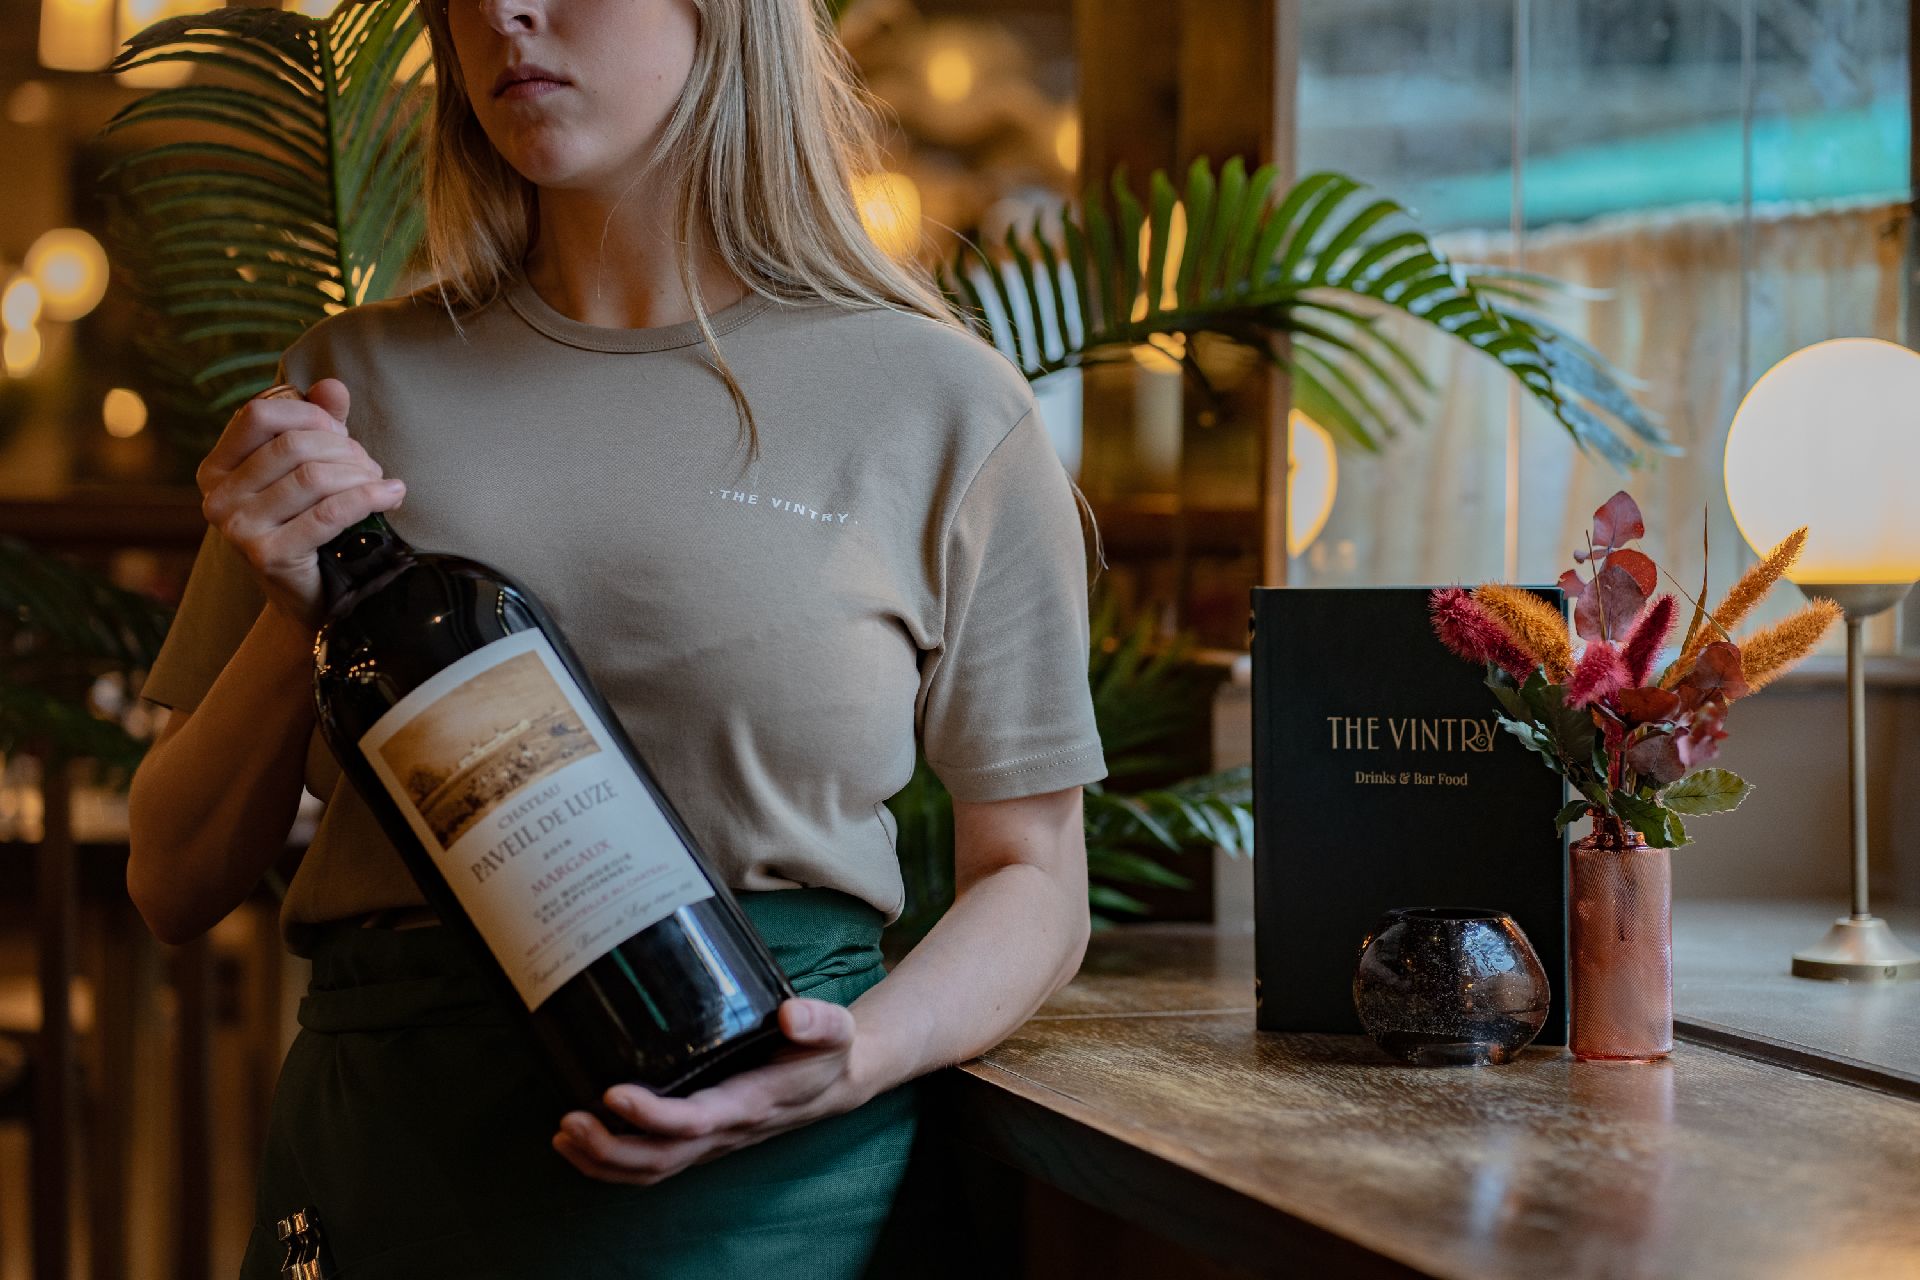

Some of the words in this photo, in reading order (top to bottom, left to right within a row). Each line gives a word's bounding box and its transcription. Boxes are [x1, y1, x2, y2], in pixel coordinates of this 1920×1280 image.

[720, 489, 759, 505] THE
[771, 497, 849, 524] VINTRY
[1327, 716, 1380, 750] THE
[1388, 717, 1499, 752] VINTRY
[1355, 770, 1396, 785] Drinks
[1400, 772, 1410, 785] &
[1414, 772, 1436, 786] Bar
[1438, 773, 1468, 786] Food
[471, 825, 540, 884] PAVEIL
[537, 807, 568, 834] DE
[564, 778, 619, 817] LUZE
[530, 838, 612, 897] MARGAUX
